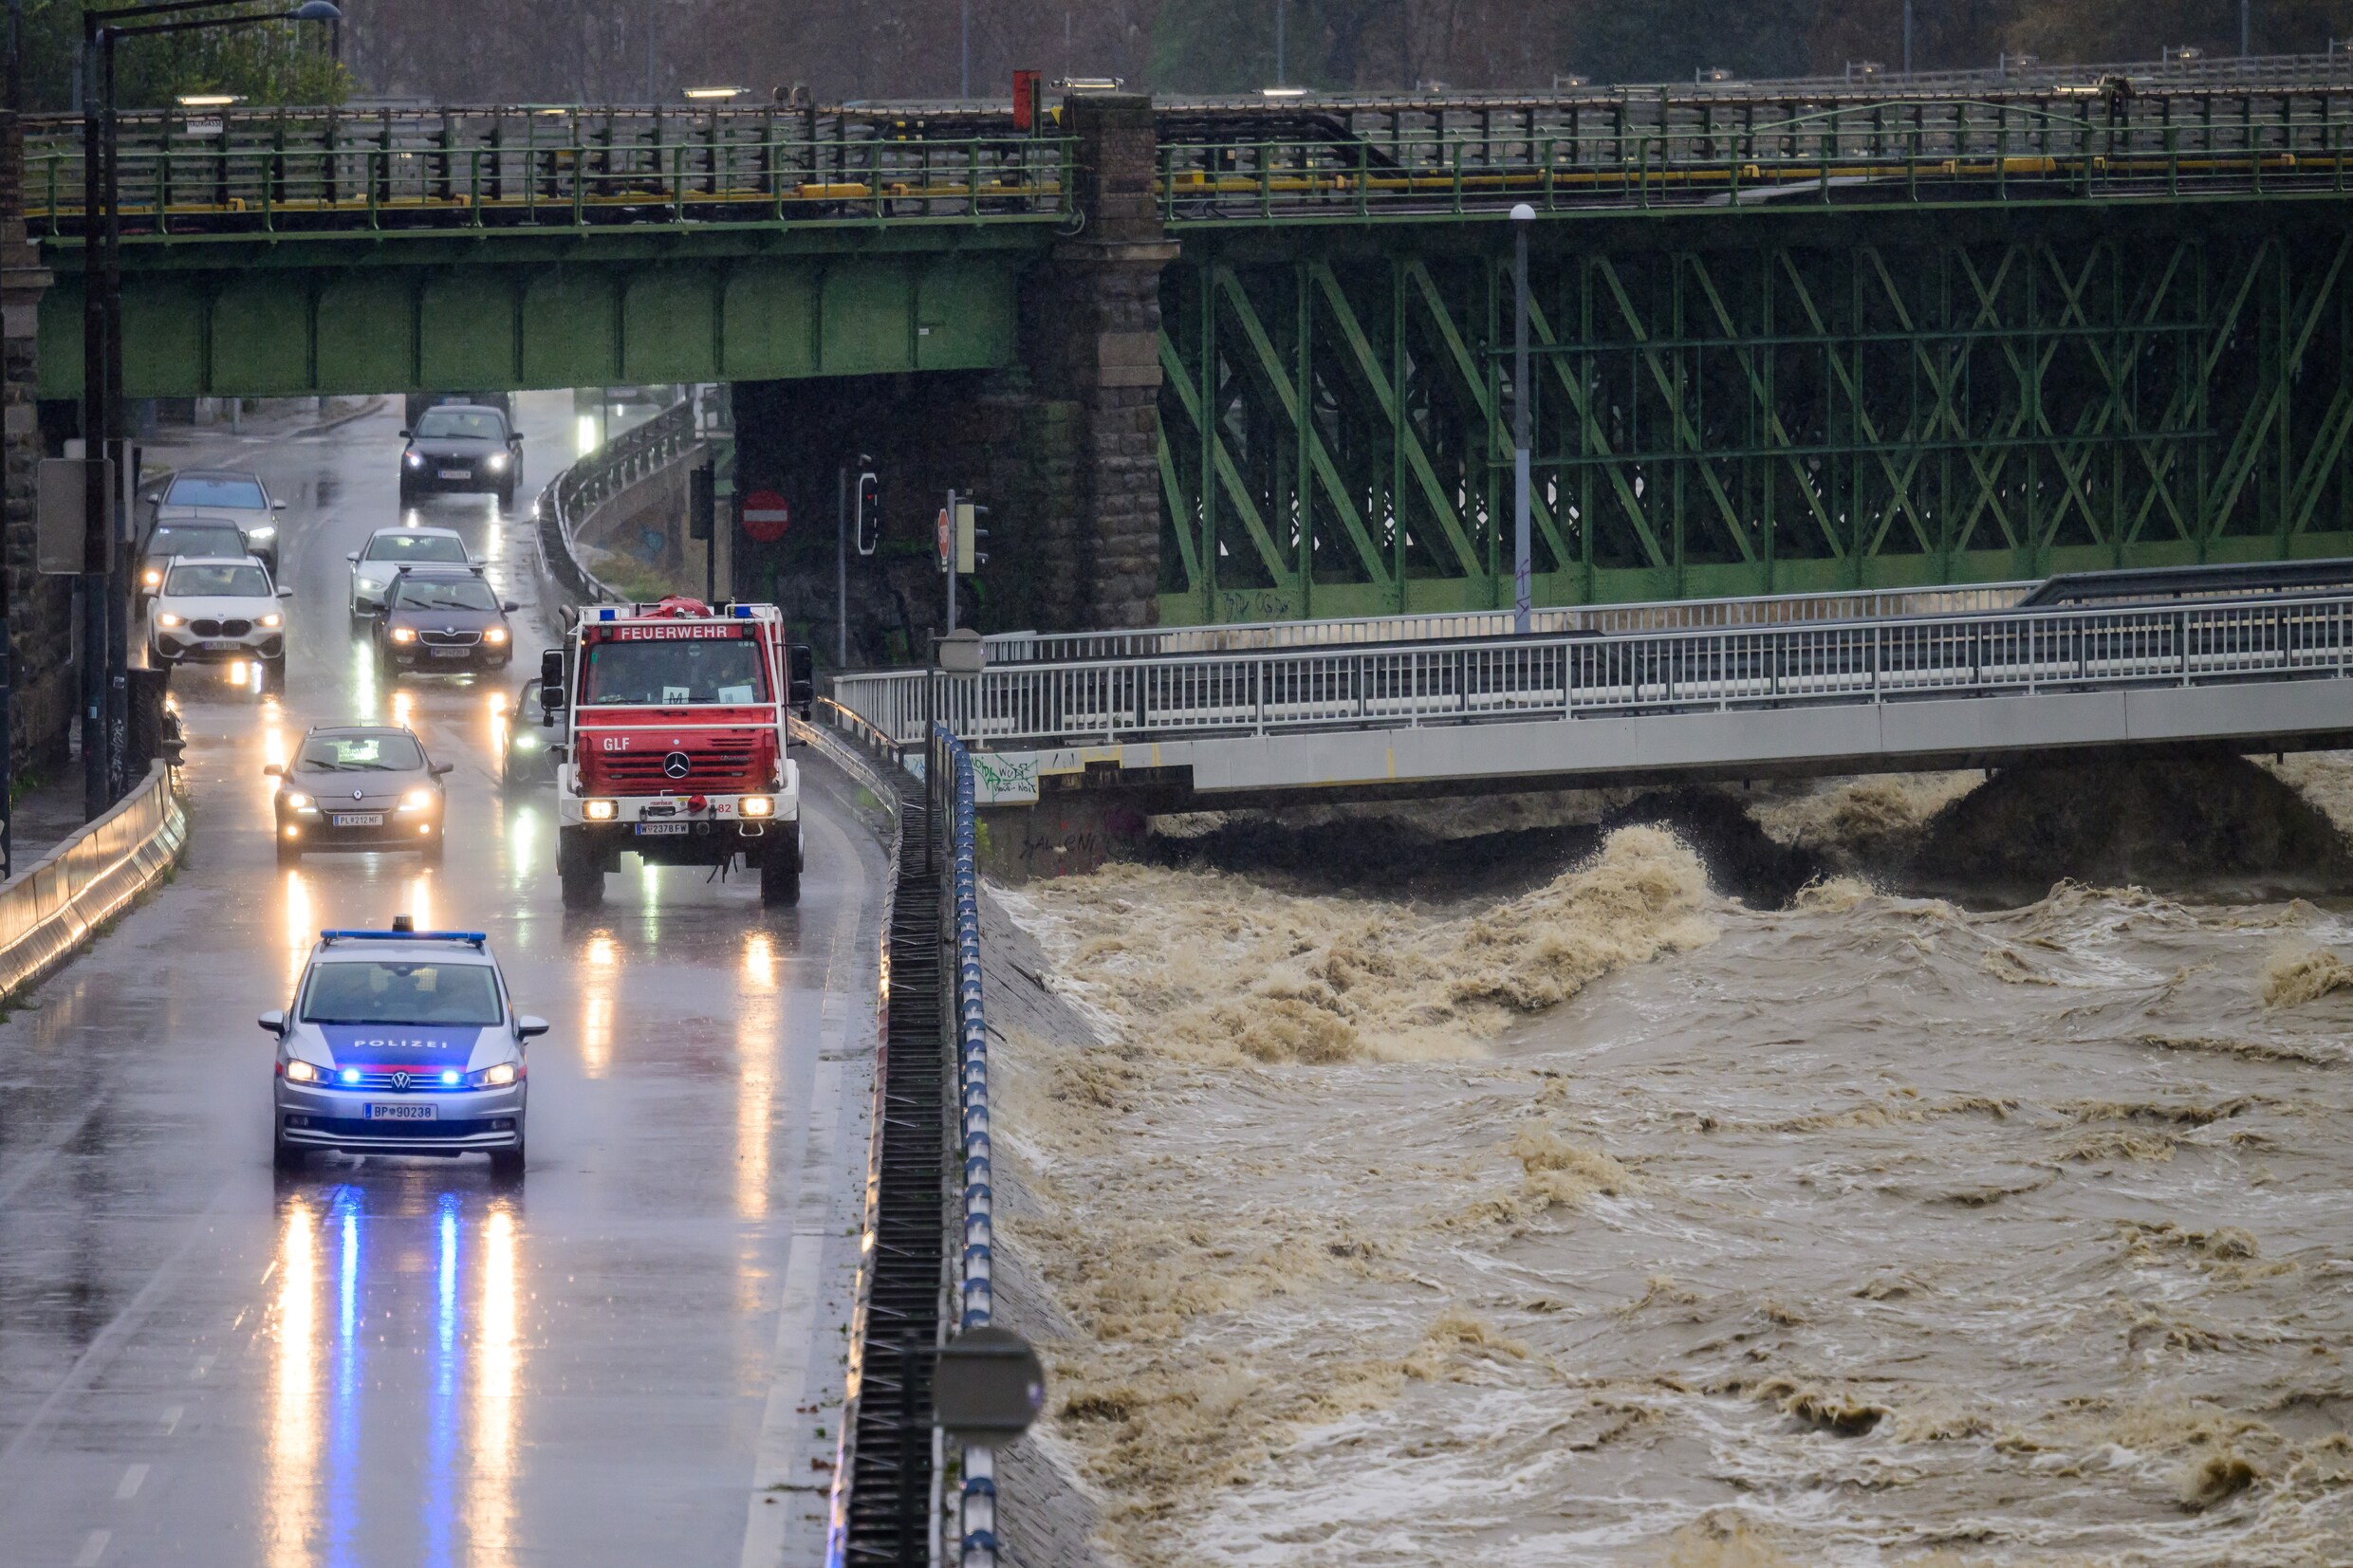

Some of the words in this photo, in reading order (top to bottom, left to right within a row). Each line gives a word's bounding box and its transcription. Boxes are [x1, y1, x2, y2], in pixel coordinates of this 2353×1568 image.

[621, 626, 728, 639] FEUERWEHR
[603, 737, 630, 750] GLF
[718, 803, 732, 813] 82
[653, 823, 674, 833] 2378
[354, 1040, 447, 1048] POLIZEI
[375, 1106, 388, 1117] BP
[397, 1107, 431, 1117] 90238
